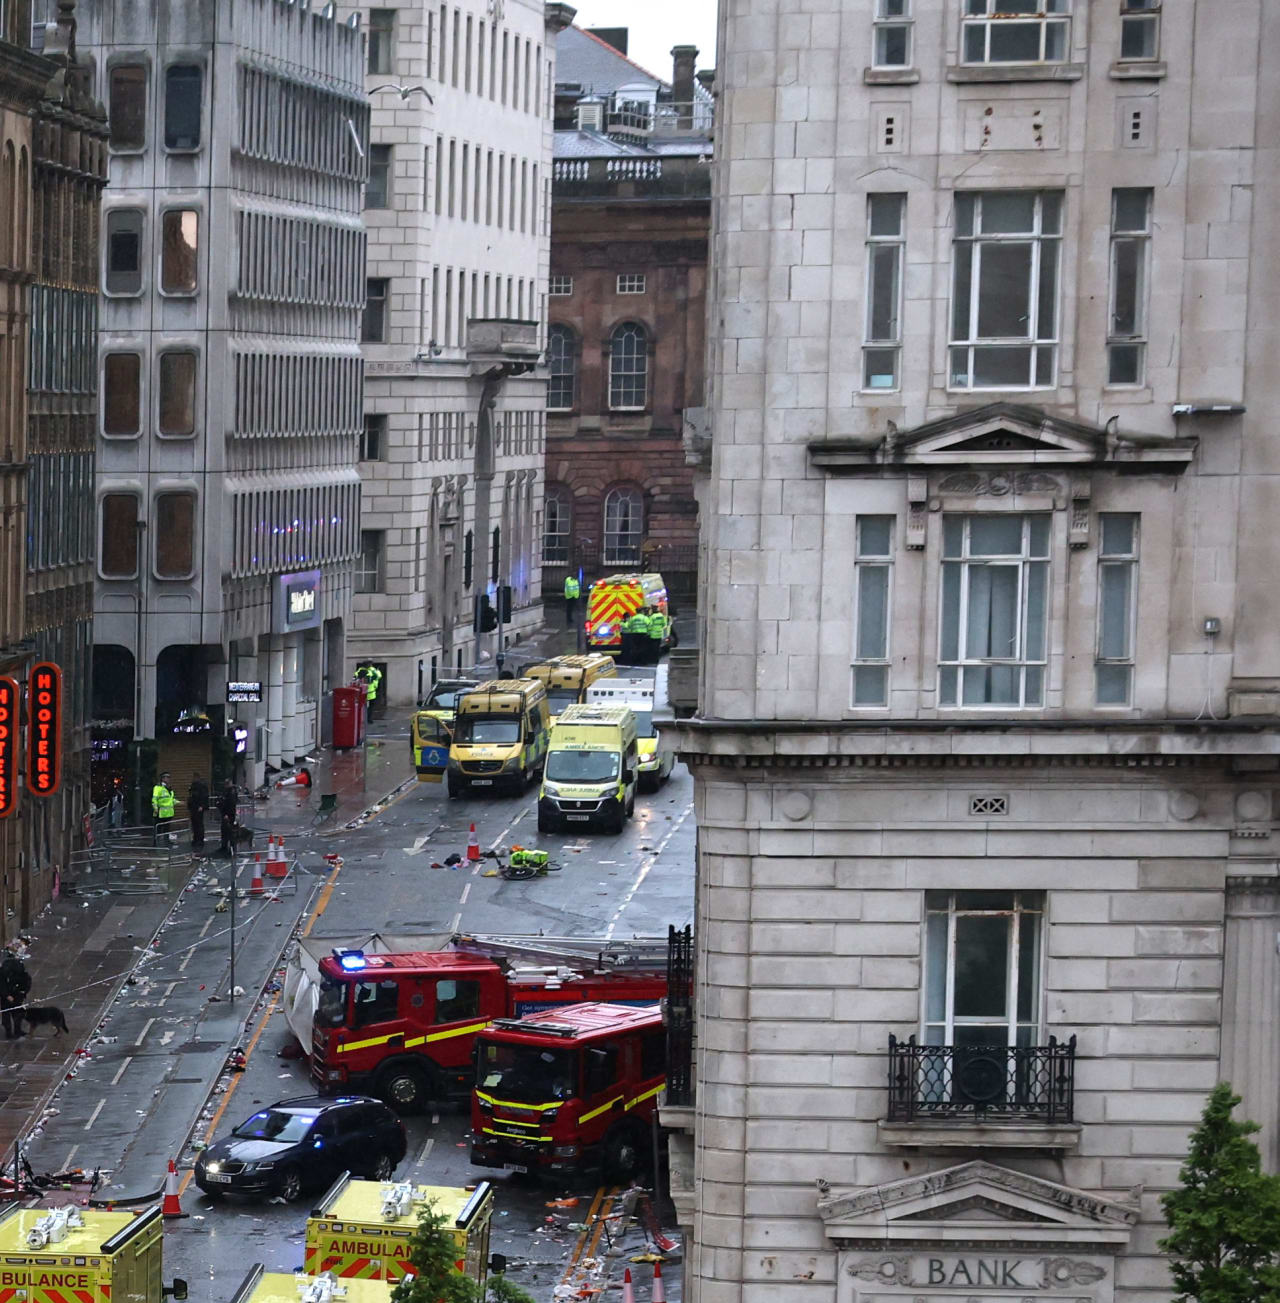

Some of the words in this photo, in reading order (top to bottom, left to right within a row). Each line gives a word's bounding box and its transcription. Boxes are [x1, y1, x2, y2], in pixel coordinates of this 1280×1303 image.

[37, 674, 52, 789] HOOTERS
[329, 1240, 414, 1258] AMBULAN
[928, 1258, 1024, 1286] BANK
